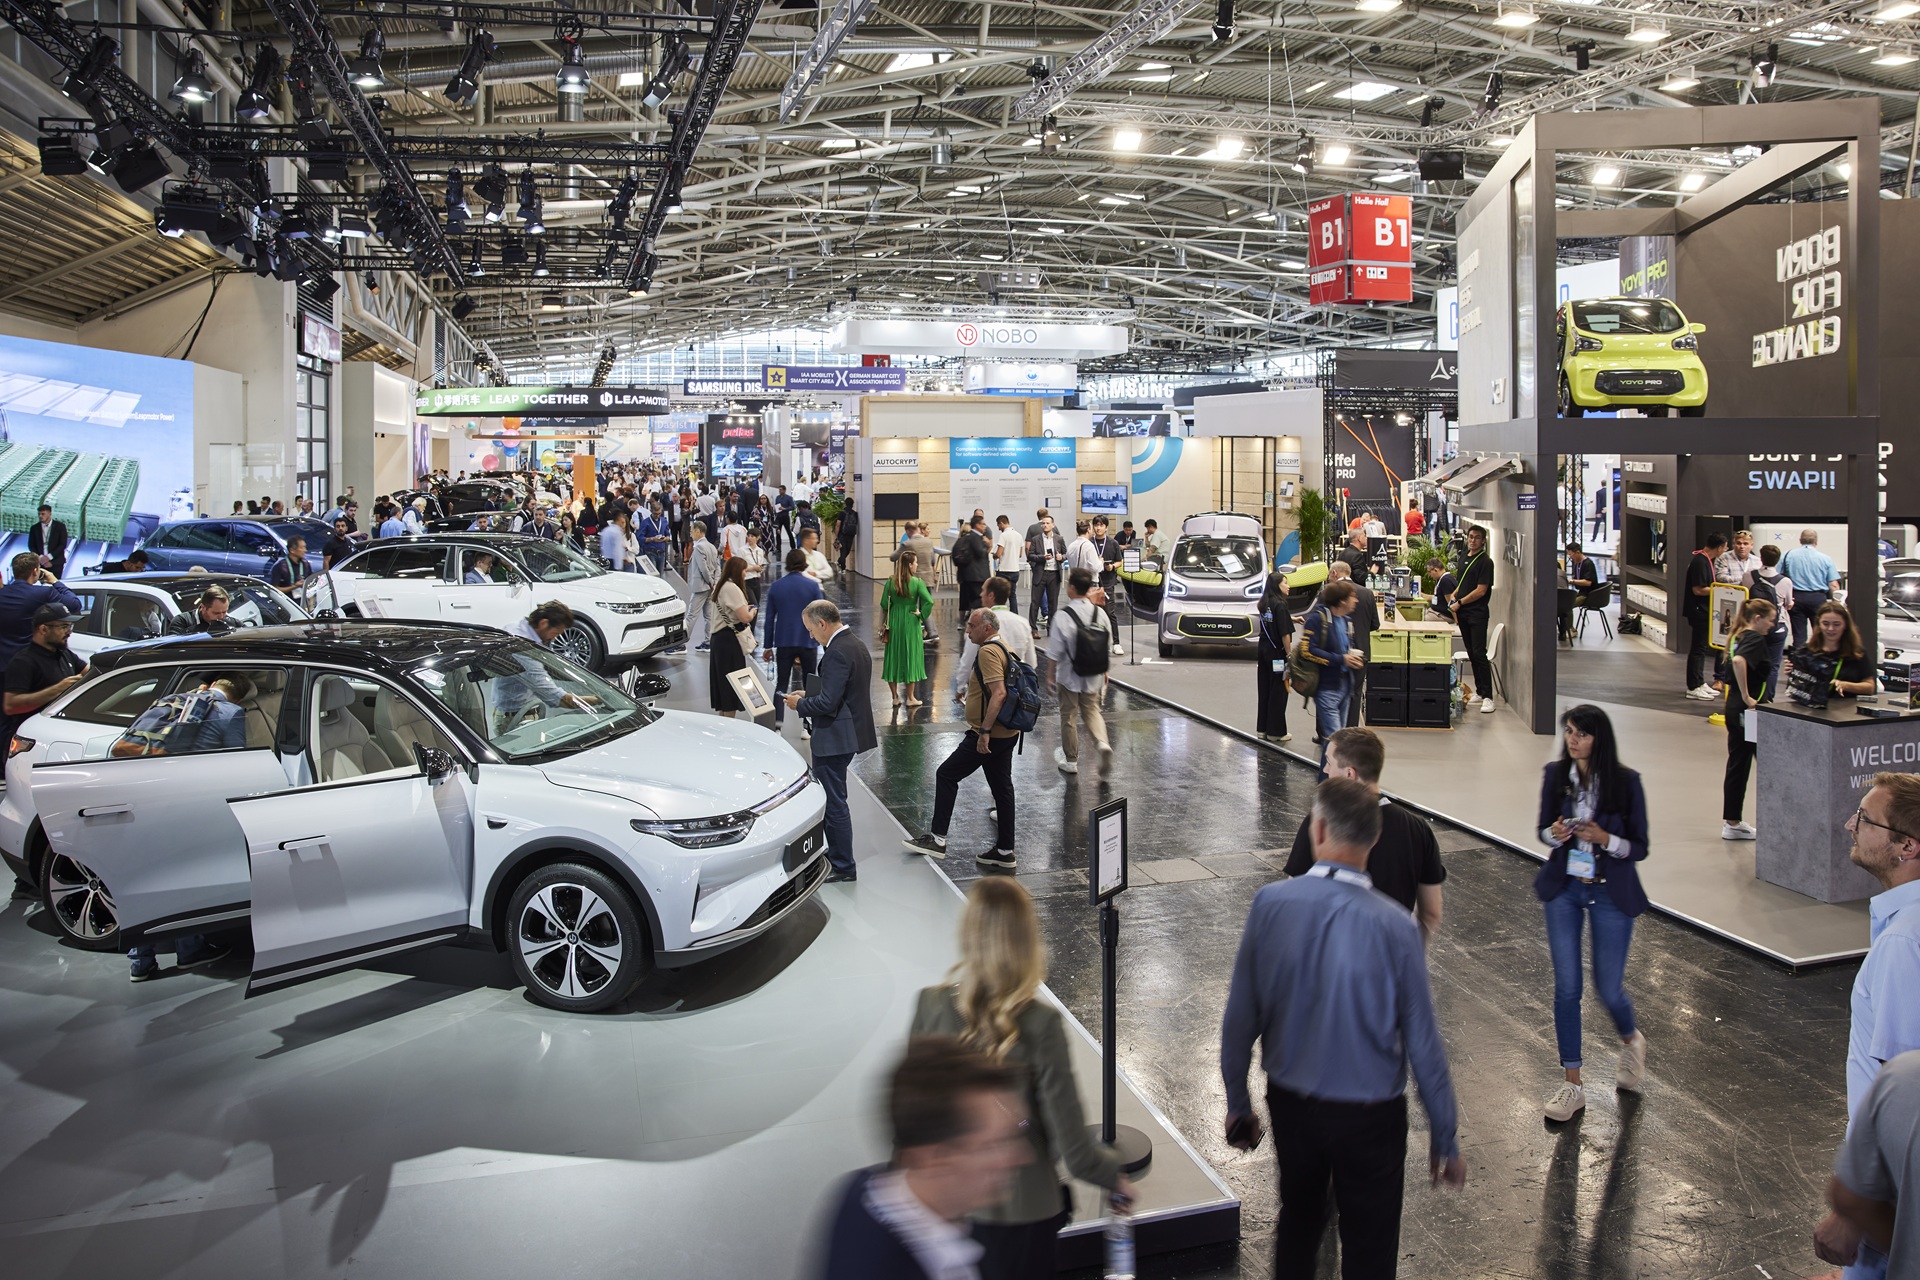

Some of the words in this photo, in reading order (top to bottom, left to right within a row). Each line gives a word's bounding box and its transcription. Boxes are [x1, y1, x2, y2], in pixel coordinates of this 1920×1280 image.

[1310, 205, 1321, 214] Halle
[1322, 200, 1331, 210] Hall
[1354, 196, 1374, 205] Halle
[1374, 198, 1390, 206] Hall
[1322, 217, 1342, 250] B1
[1375, 217, 1408, 247] B1
[1647, 259, 1668, 283] PRO
[982, 328, 1038, 344] NOBO
[688, 382, 742, 393] SAMSUNG
[1085, 381, 1174, 399] SAMSUNG
[489, 394, 520, 404] LEAP
[522, 394, 589, 404] TOGETHER
[614, 394, 668, 406] LEAPMOTOR
[1336, 468, 1356, 479] PRO
[1748, 470, 1836, 490] SWAP!!
[1850, 742, 1920, 768] WELCO
